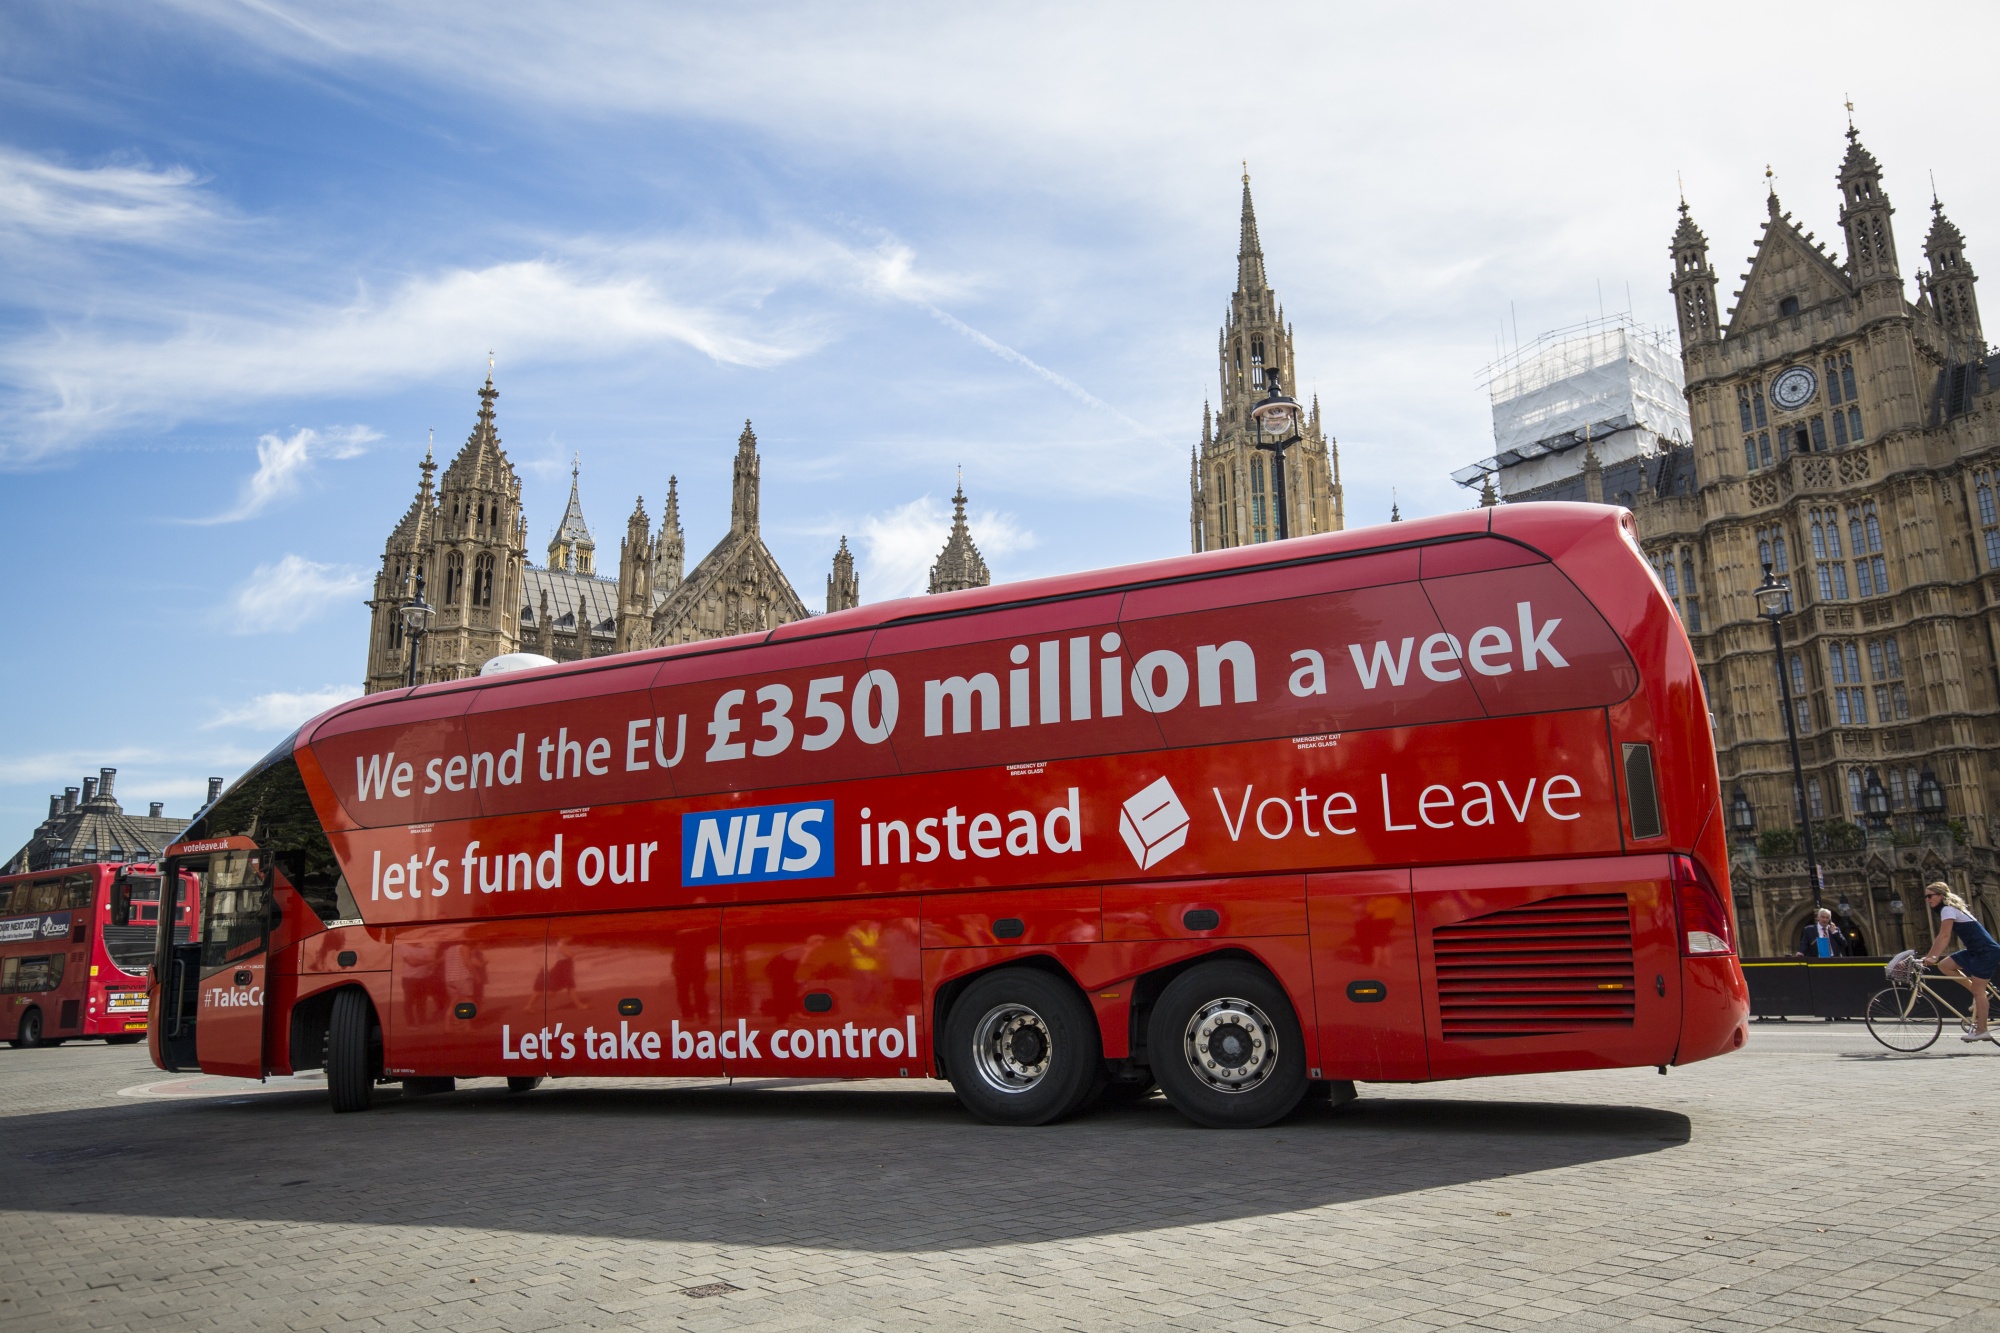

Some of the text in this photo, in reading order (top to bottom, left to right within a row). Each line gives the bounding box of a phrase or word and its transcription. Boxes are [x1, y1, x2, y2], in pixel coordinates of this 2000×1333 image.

[356, 601, 1570, 802] We send the EU £350 million a week
[1292, 733, 1342, 744] EMERGENCY EXIT
[1297, 740, 1338, 750] BREAK GLASS
[1006, 763, 1037, 771] EMERGENCY
[371, 773, 1582, 901] let's fund our NHS instead Vote Leave
[183, 840, 229, 853] voteleave.uk
[502, 1015, 917, 1060] Let's take back control
